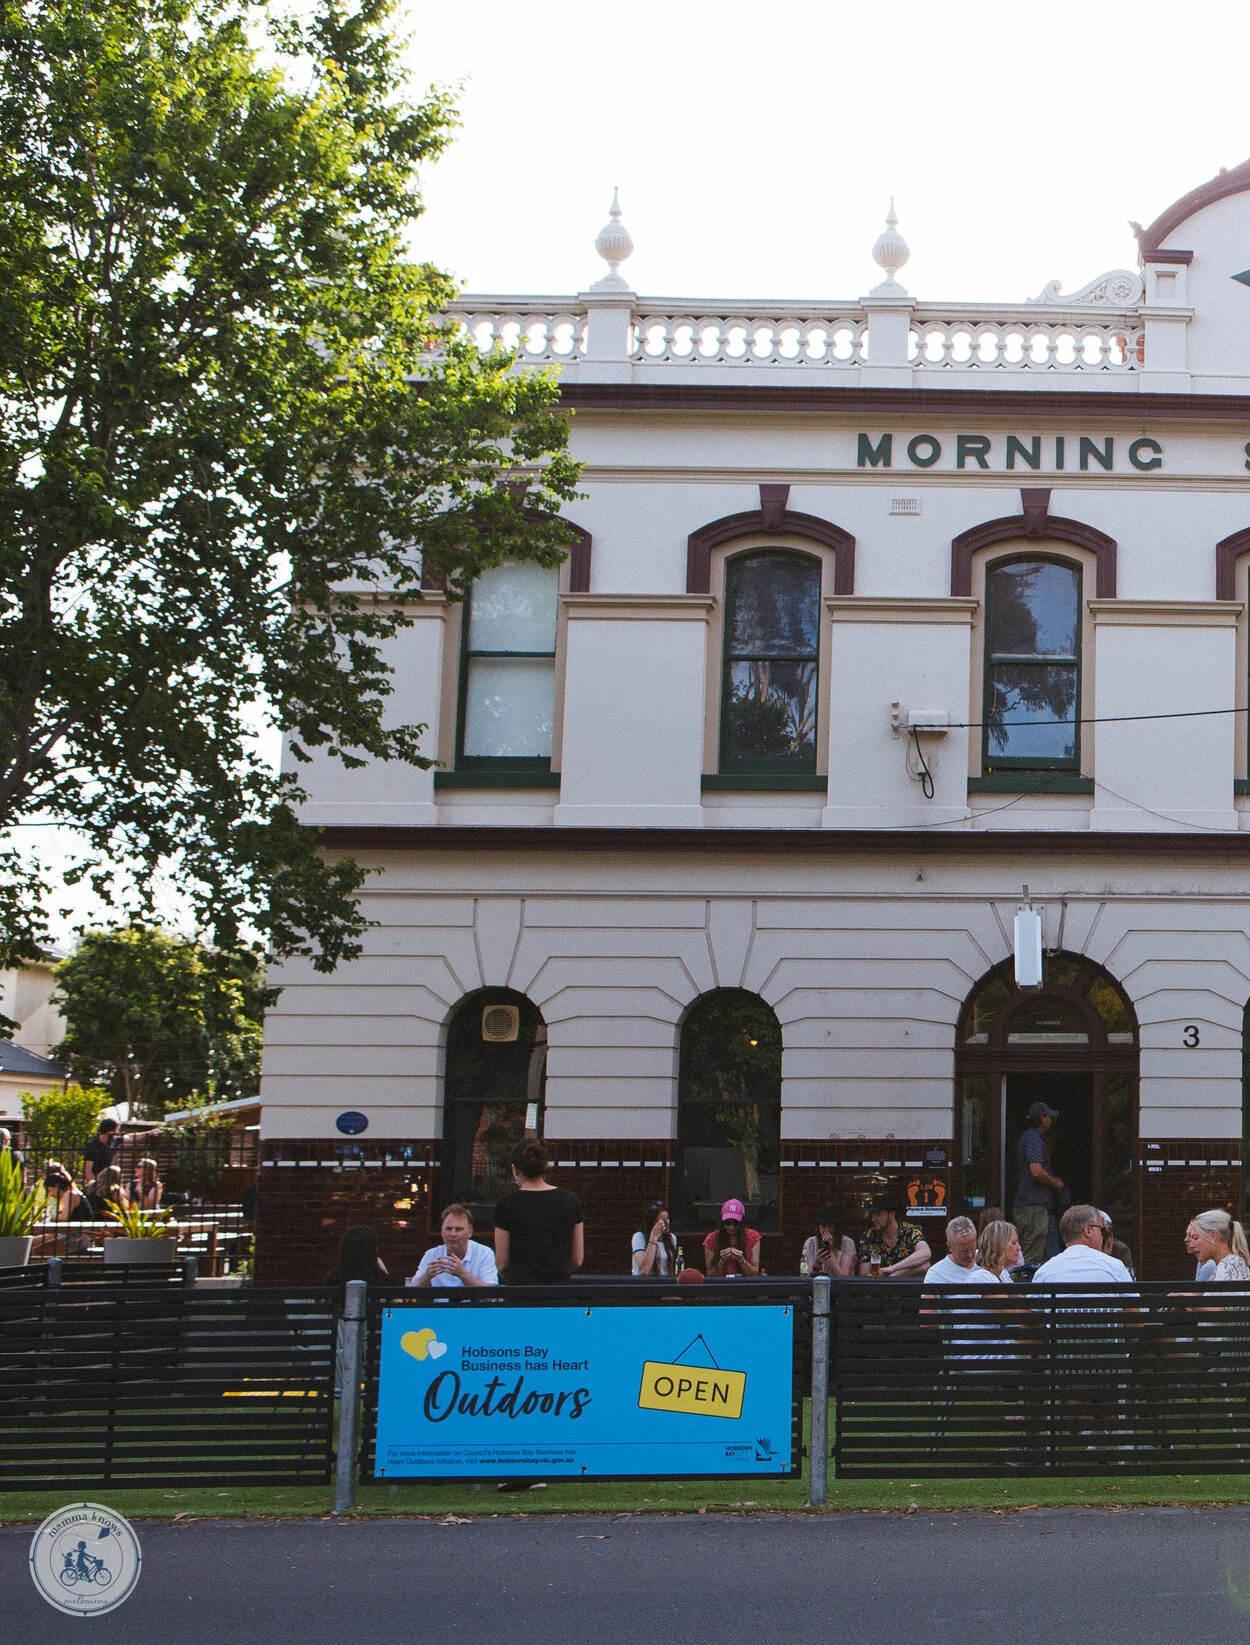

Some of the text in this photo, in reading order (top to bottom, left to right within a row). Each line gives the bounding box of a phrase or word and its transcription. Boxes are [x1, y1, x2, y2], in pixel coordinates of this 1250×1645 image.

[857, 432, 1163, 471] MORNING
[1182, 1024, 1201, 1049] 3
[461, 1345, 549, 1360] Hobsons Bay
[461, 1359, 589, 1371] Business has Heart
[423, 1370, 593, 1423] Outdoors
[653, 1376, 731, 1404] OPEN
